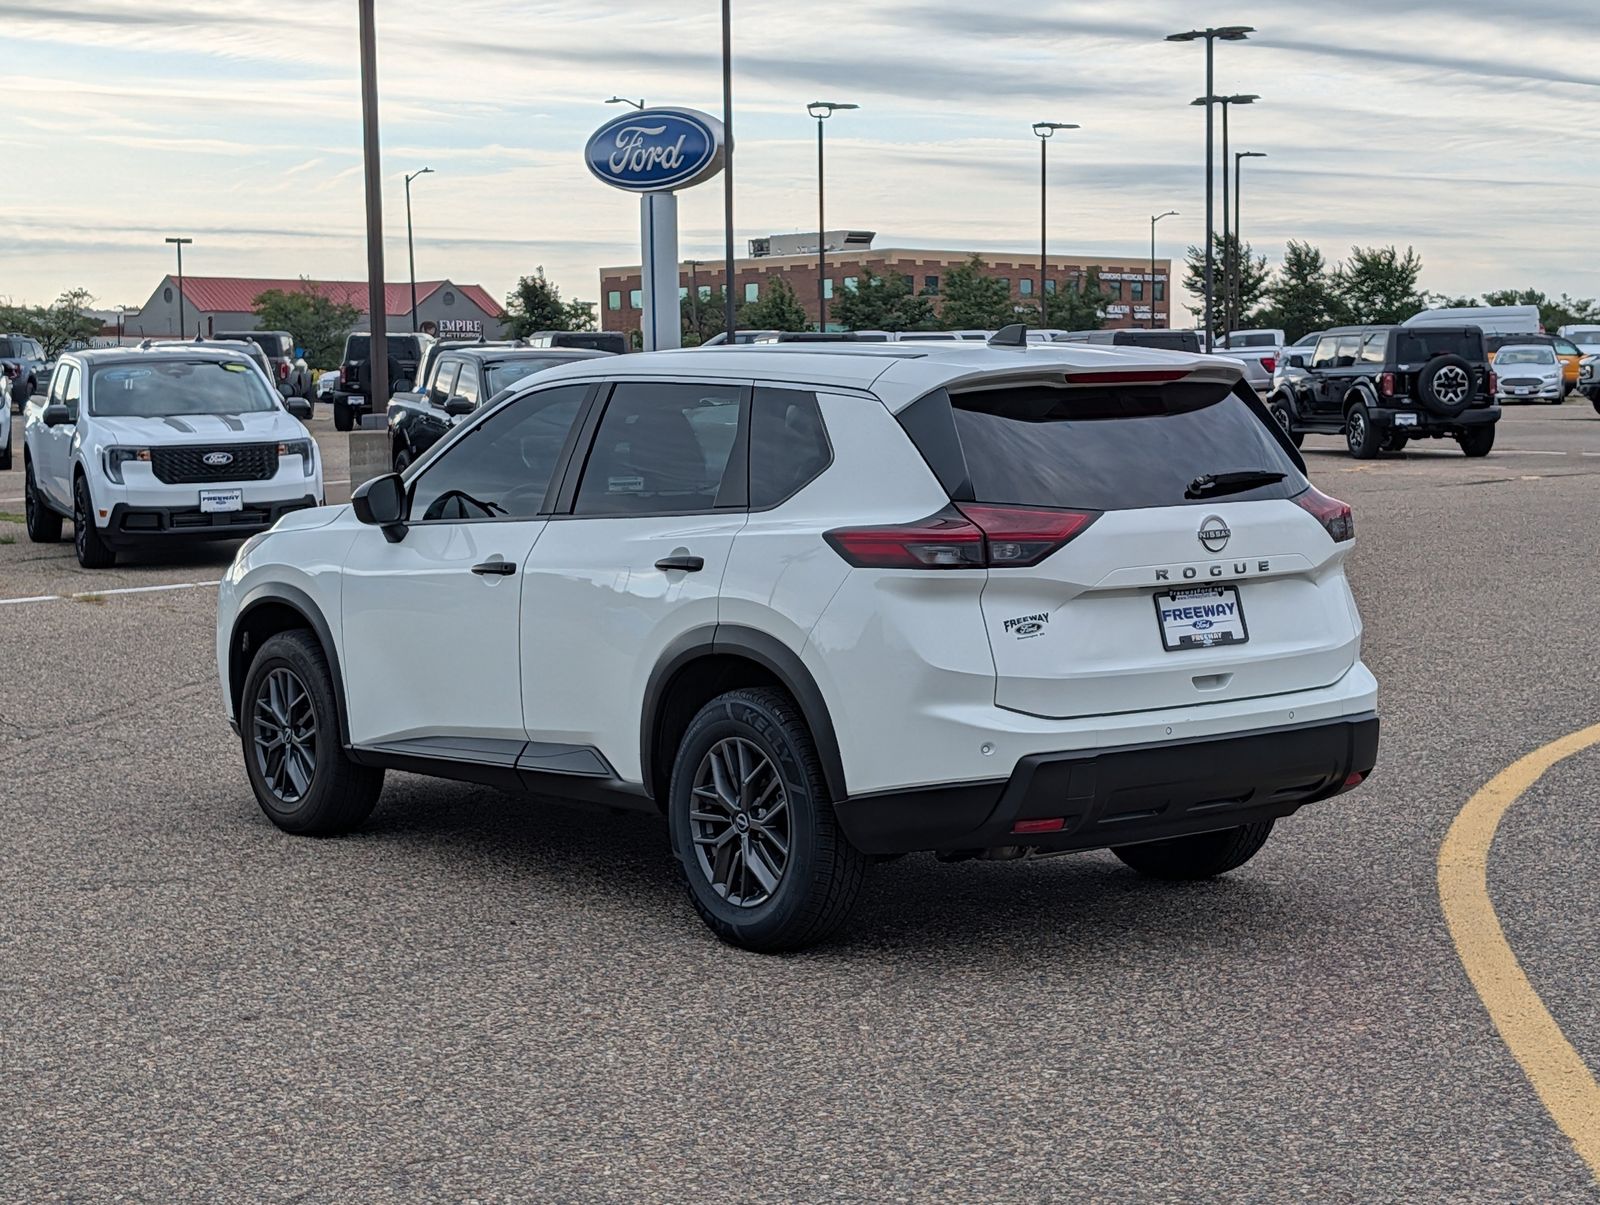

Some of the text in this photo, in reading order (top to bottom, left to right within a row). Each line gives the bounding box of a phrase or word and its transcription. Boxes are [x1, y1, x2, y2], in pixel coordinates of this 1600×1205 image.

[608, 125, 687, 175] Ford
[440, 320, 481, 331] EMPIRE
[1199, 528, 1231, 540] NISSAN
[1155, 560, 1270, 581] ROGUE
[1162, 602, 1235, 622] FREEWAY
[1003, 612, 1049, 633] FREEWAY
[1191, 631, 1222, 642] FREEWAY
[742, 708, 793, 762] KELLY
